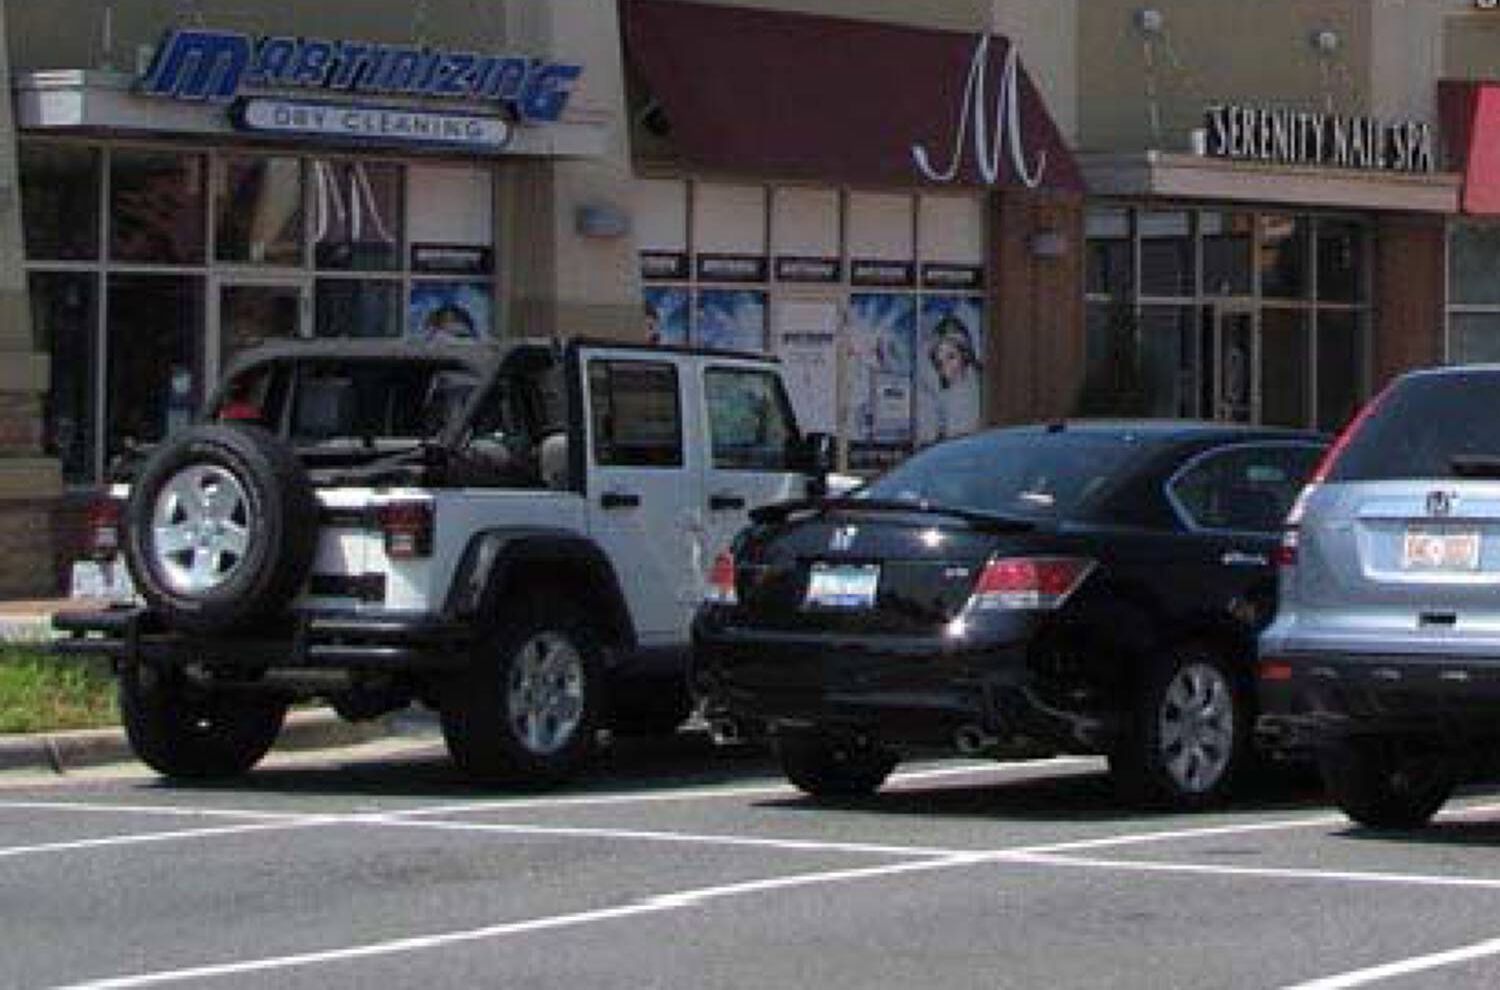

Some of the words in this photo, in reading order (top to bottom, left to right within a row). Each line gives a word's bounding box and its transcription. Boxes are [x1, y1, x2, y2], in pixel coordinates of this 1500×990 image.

[274, 106, 332, 129] DRY
[343, 110, 486, 140] CLEANING
[1206, 106, 1325, 162] SERENITY
